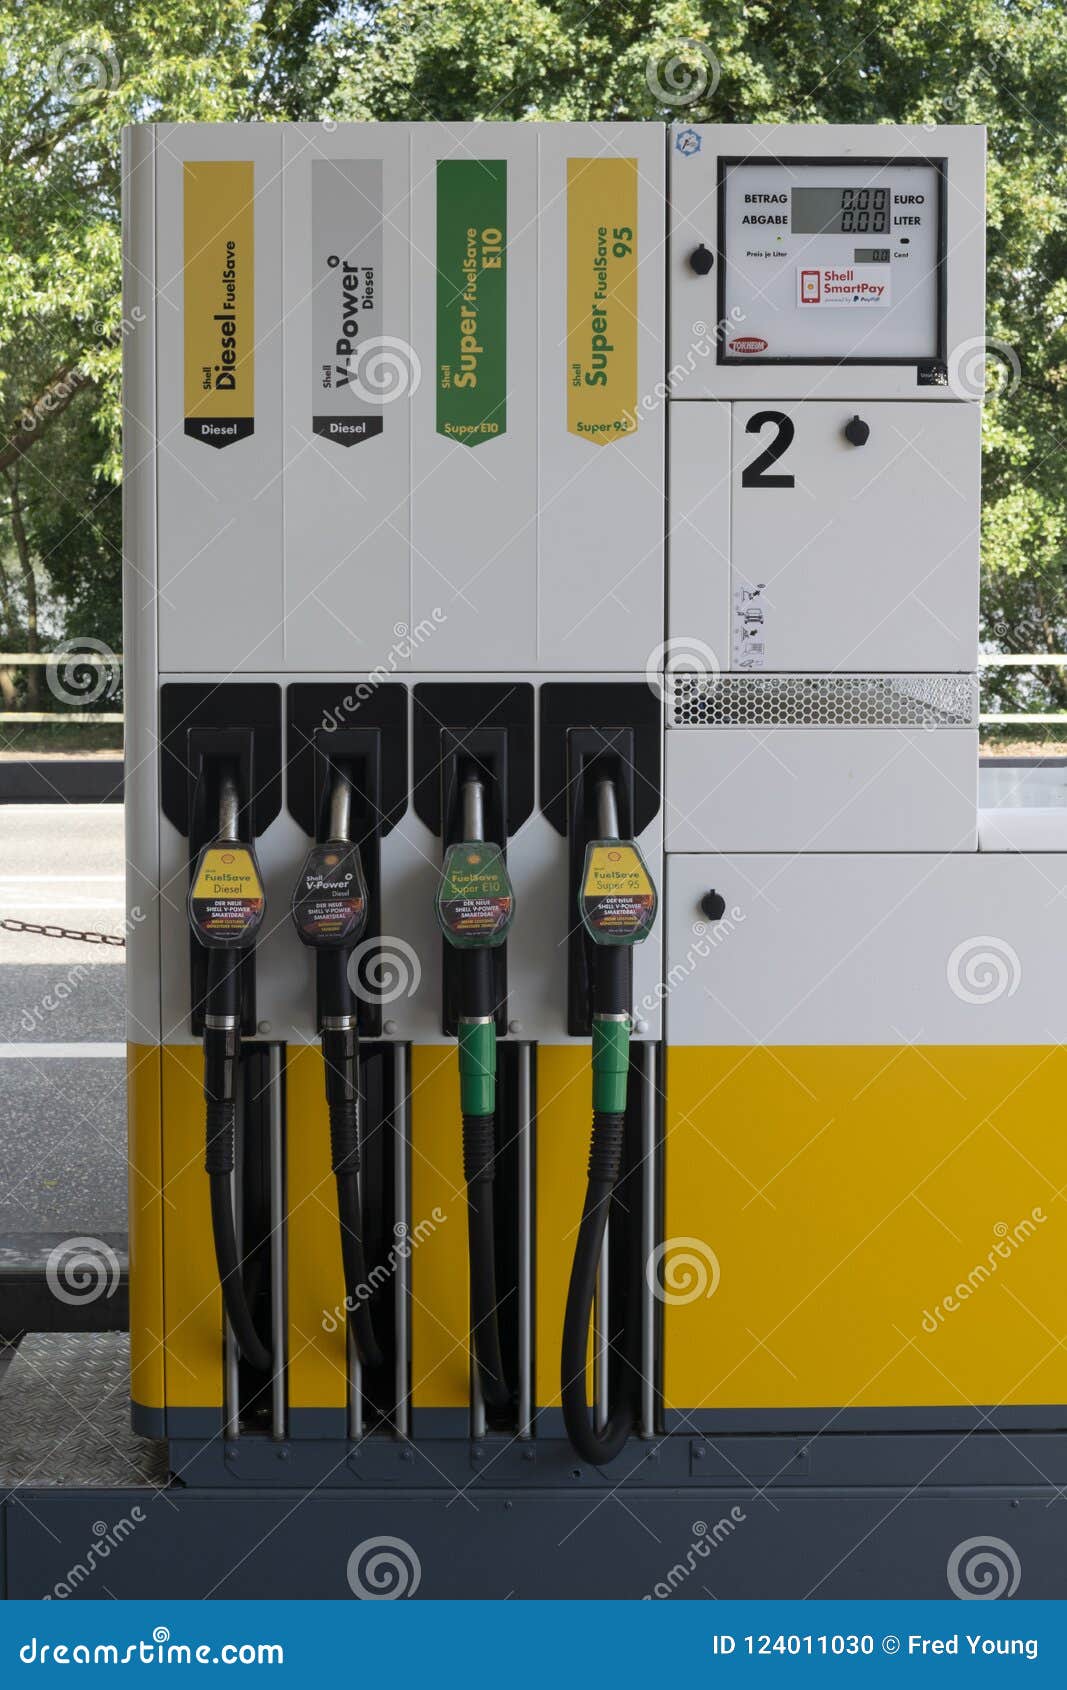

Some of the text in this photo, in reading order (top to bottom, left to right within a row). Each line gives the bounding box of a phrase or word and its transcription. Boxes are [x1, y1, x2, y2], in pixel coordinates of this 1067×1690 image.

[744, 194, 788, 204] BETRAG
[894, 195, 925, 204] EURO
[742, 216, 788, 225] ABGABE
[894, 216, 921, 225] LITER
[481, 228, 502, 269] E10
[613, 227, 633, 258] 95
[824, 270, 854, 281] Shell
[362, 267, 373, 309] Diesel
[824, 283, 885, 296] SmartPay
[454, 228, 483, 388] Super FuelSave
[585, 227, 614, 387] Super FuelSave
[214, 241, 236, 390] Diesel FuelSave
[336, 261, 358, 388] V-Power
[203, 367, 212, 390] Shell
[322, 365, 331, 388] Shell
[442, 365, 451, 389] Shell
[573, 364, 581, 387] Shell
[201, 424, 237, 435] Diesel
[330, 423, 366, 434] Diesel
[445, 423, 498, 435] Super E10
[577, 422, 611, 434] Super
[742, 411, 795, 488] 2
[452, 874, 498, 882] FuelSave
[214, 884, 242, 893] Diesel
[306, 881, 350, 889] V-Power
[451, 882, 500, 894] Super E10
[596, 880, 640, 892] Super 95
